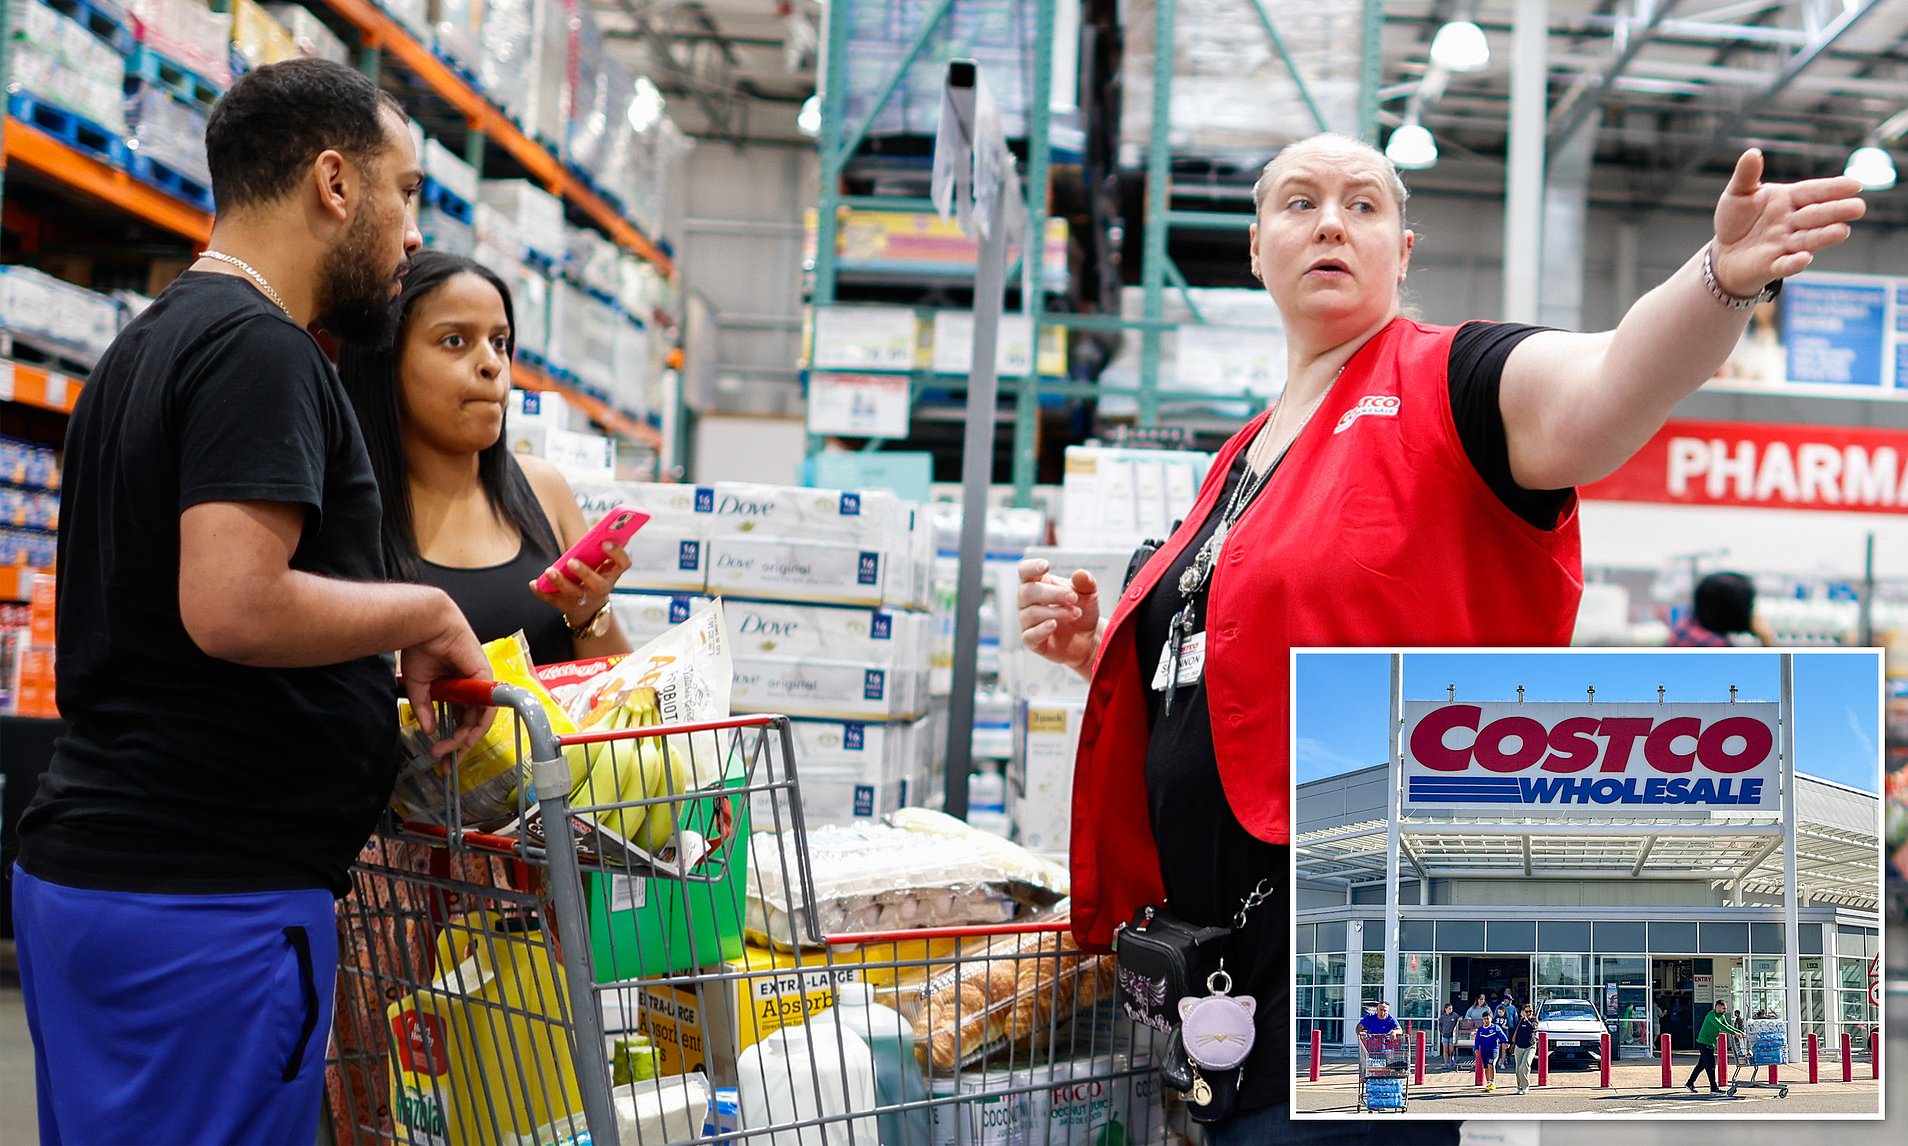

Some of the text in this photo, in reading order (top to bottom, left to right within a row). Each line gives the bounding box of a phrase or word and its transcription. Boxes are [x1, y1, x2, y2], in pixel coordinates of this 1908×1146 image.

[1666, 437, 1908, 507] PHARM
[717, 495, 775, 517] Dove
[716, 552, 755, 569] Dove
[740, 612, 798, 637] Dove
[1410, 704, 1773, 773] COSTCO
[1519, 777, 1764, 805] WHOLESALE
[1694, 975, 1712, 983] ENTRY
[1052, 1081, 1102, 1105] FOCO
[1050, 1102, 1087, 1118] OCONUT
